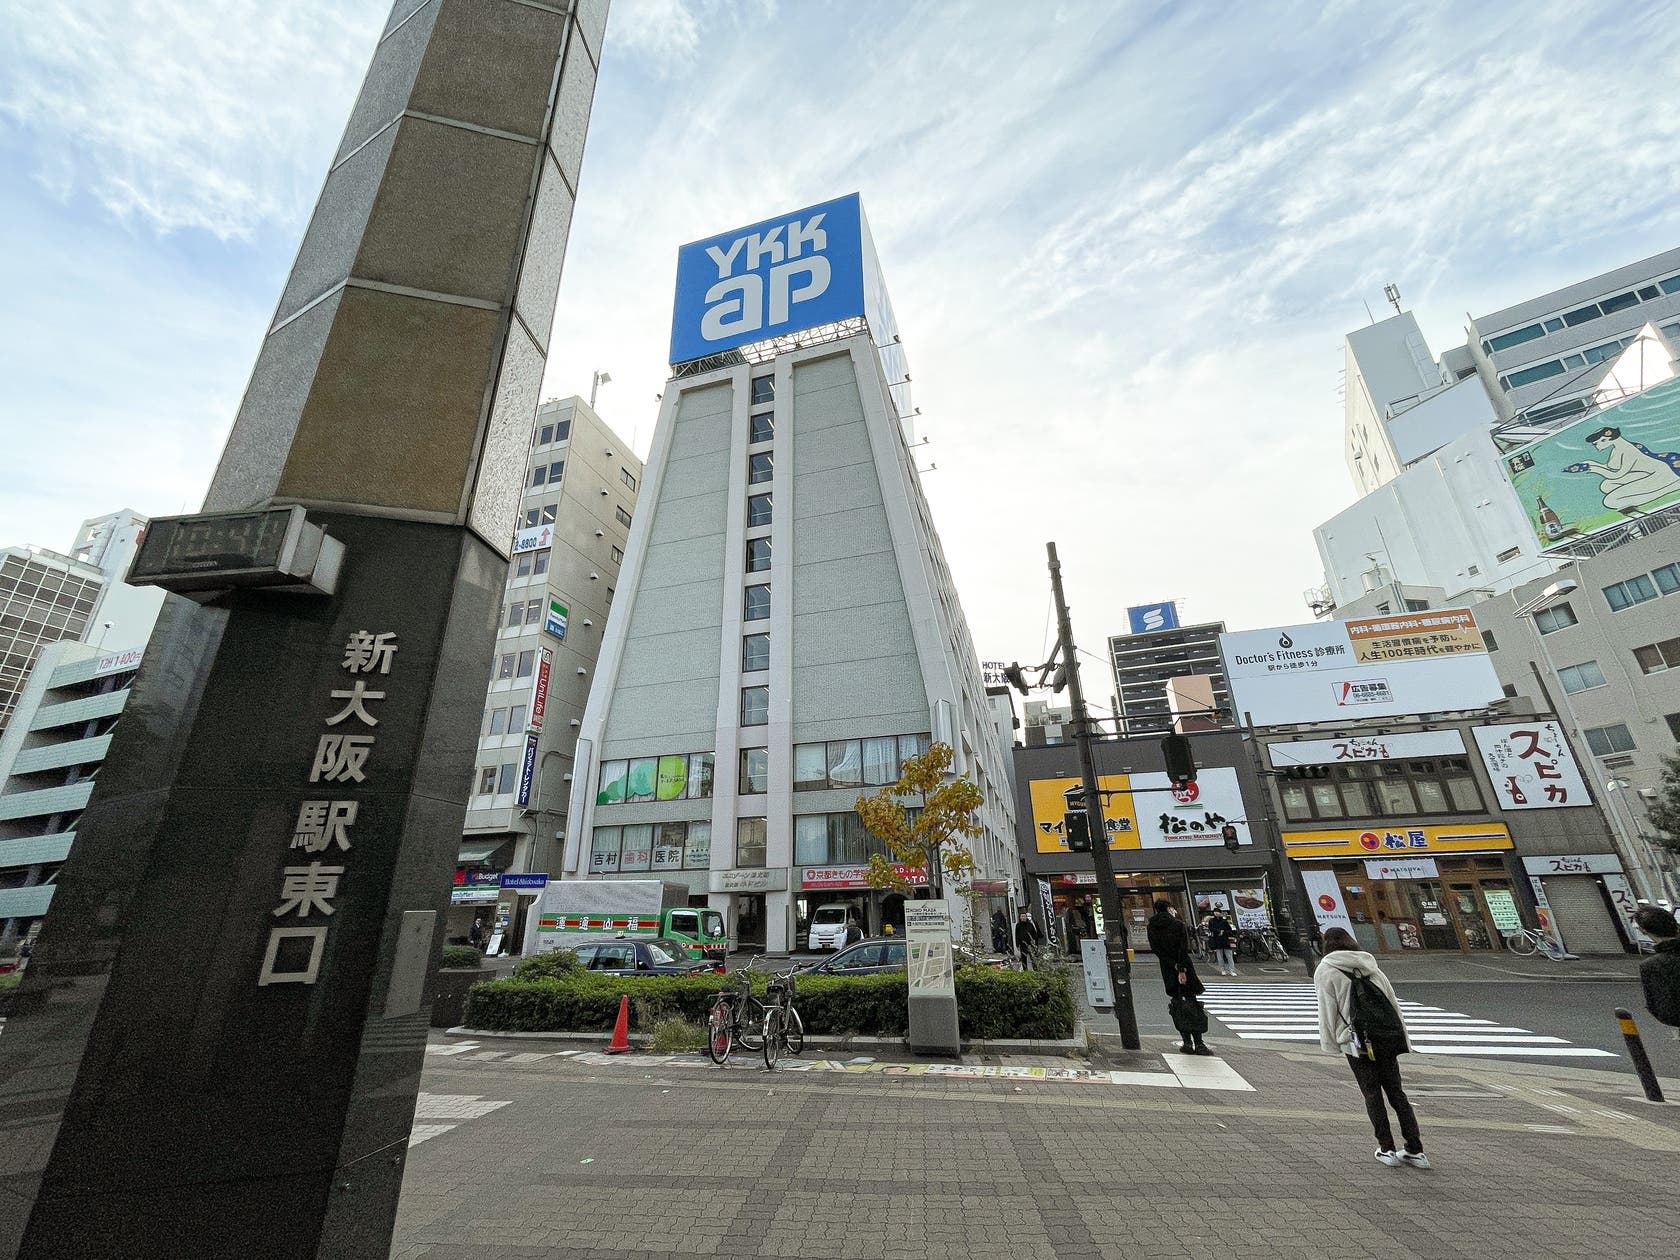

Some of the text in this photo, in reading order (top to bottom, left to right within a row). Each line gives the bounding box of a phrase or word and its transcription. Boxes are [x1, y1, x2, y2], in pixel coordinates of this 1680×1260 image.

[704, 212, 828, 279] YKK
[700, 254, 832, 341] ap
[1235, 644, 1346, 666] Doctor's Fitness 診療所
[1268, 660, 1319, 671] 駅から徒歩1分
[1335, 744, 1377, 760] スピカ
[1509, 730, 1568, 803] スピカ
[257, 629, 399, 987] 新大阪駅東口
[1158, 812, 1226, 834] 松のや
[1384, 830, 1429, 849] 松屋
[594, 852, 618, 865] 吉村
[624, 851, 648, 864] 歯科
[655, 850, 680, 863] 医院
[1549, 860, 1583, 872] スピカ
[478, 873, 498, 881] Budget
